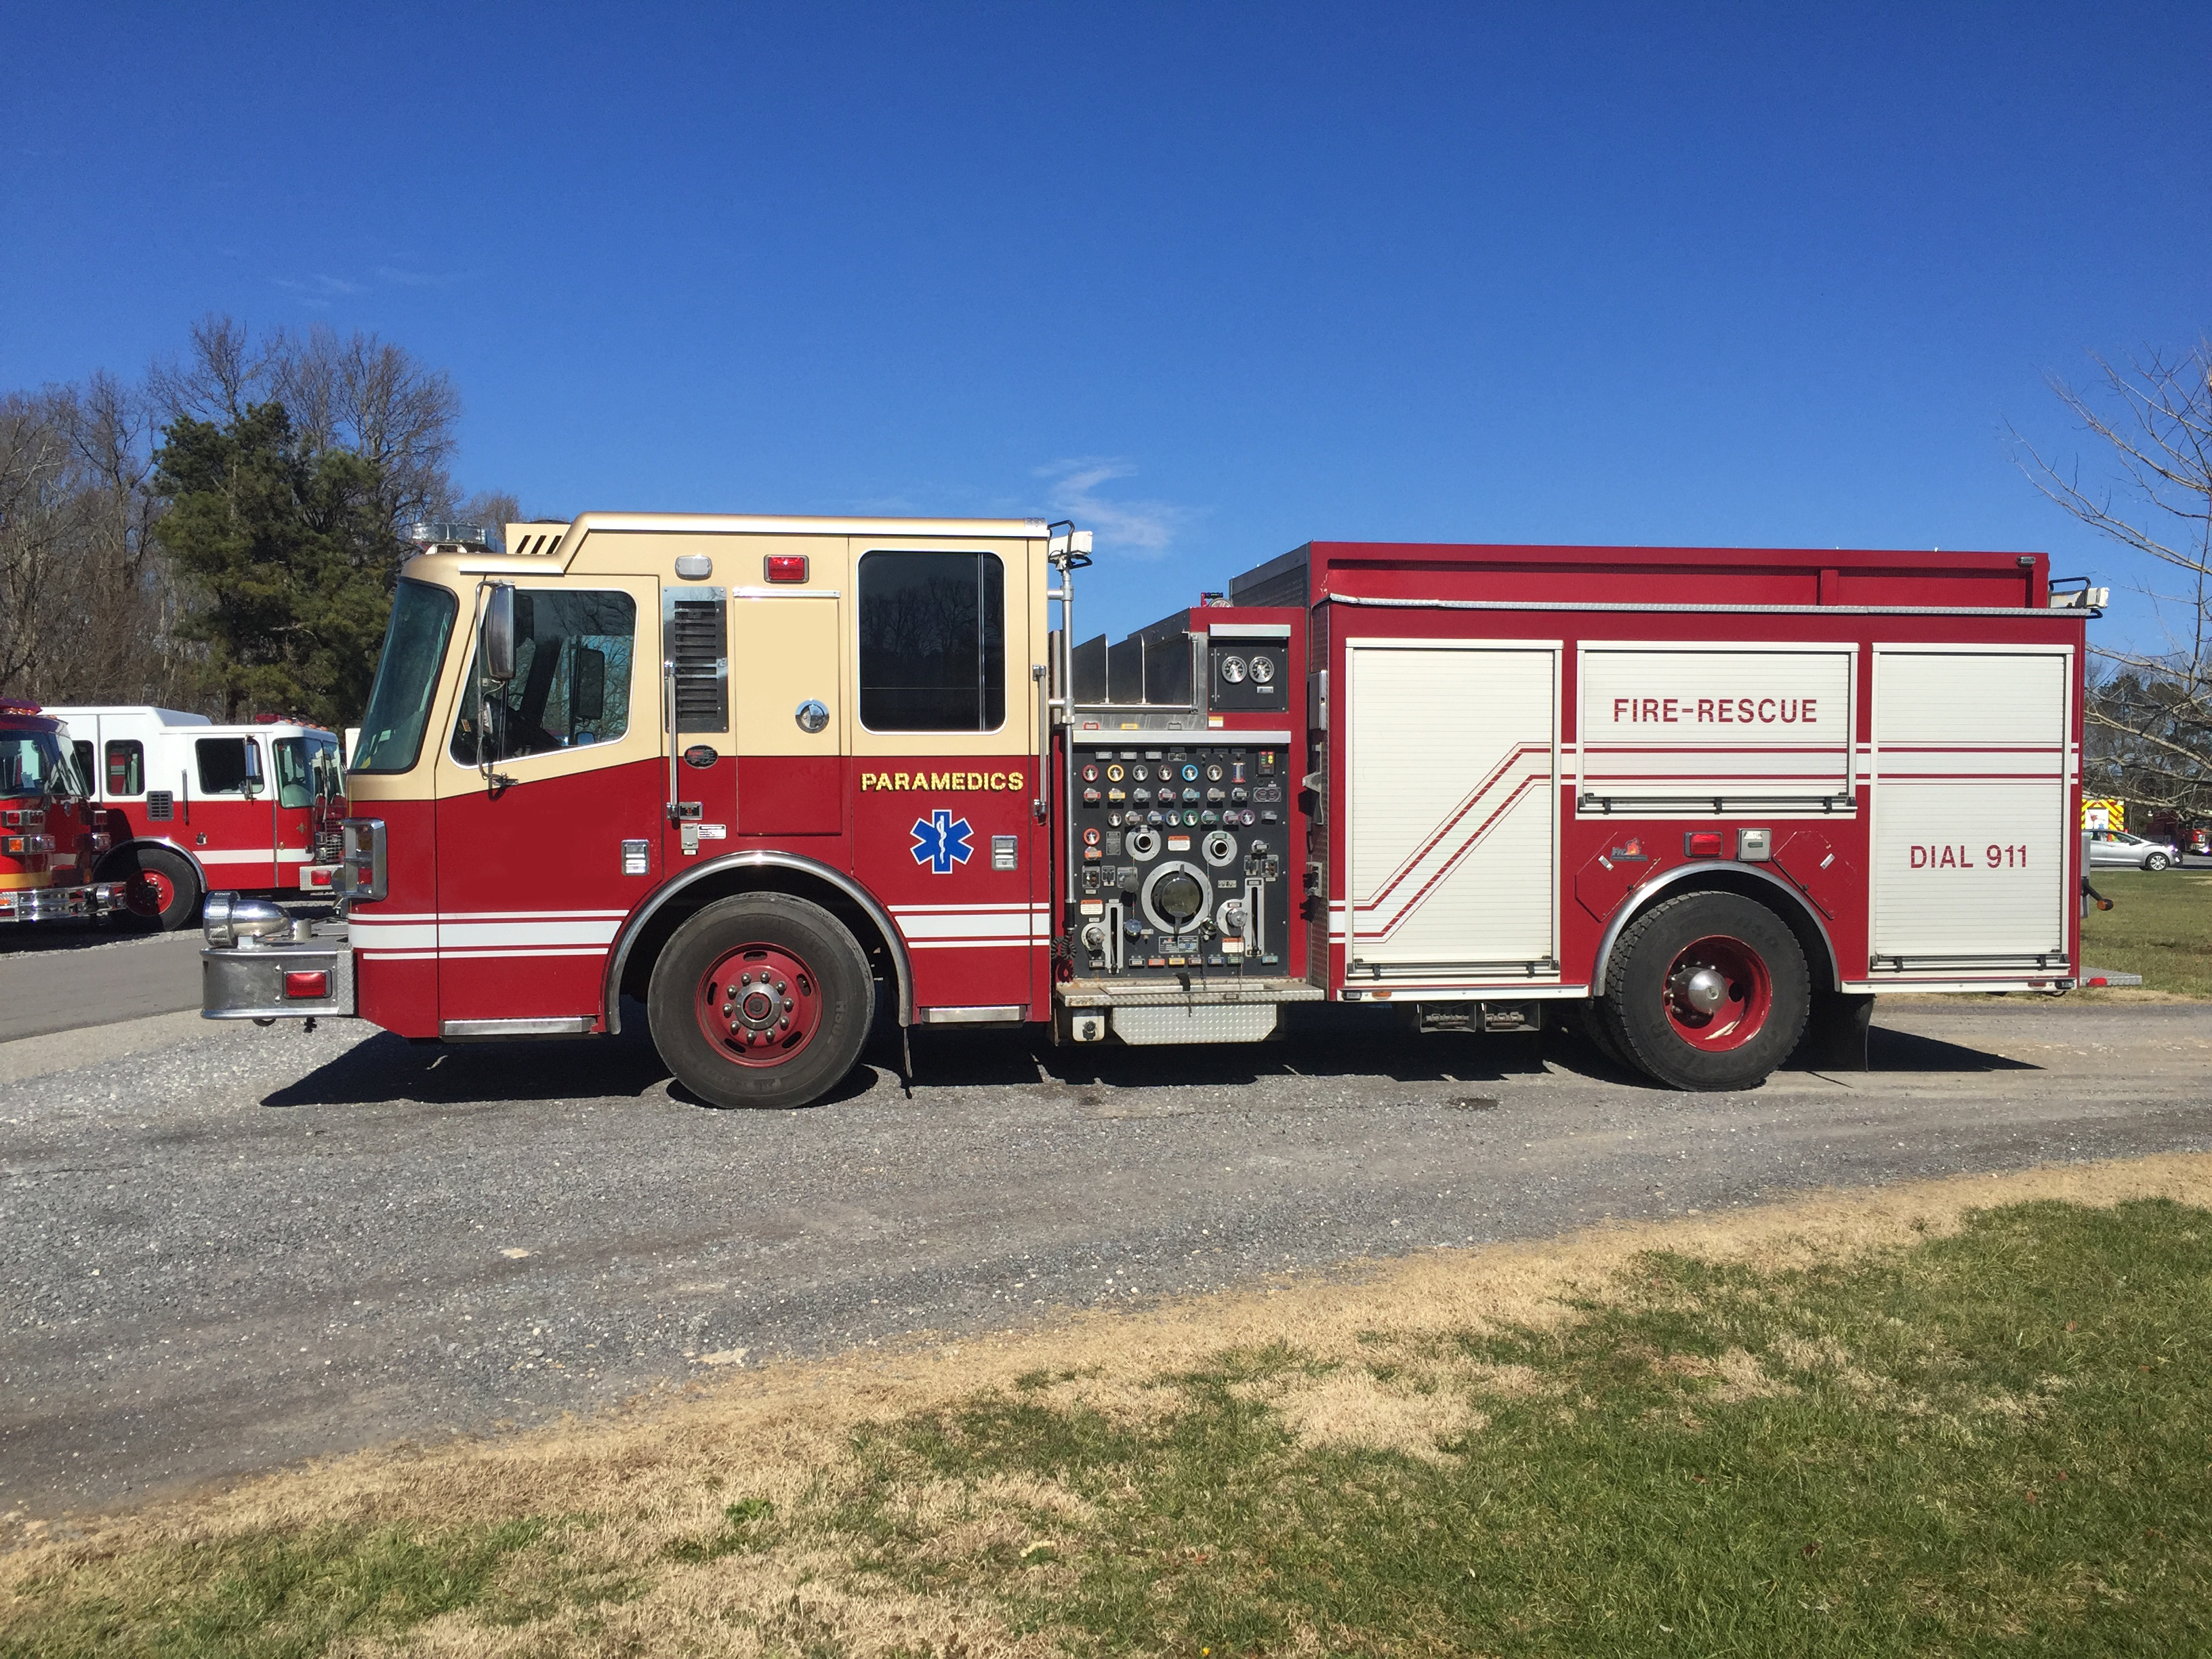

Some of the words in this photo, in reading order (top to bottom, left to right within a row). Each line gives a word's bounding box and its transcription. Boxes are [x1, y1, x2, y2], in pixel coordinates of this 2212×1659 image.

[1614, 698, 1817, 723] FIRE-RESCUE
[861, 772, 1024, 792] PARAMEDICS
[1910, 845, 1974, 869] DIAL
[1986, 844, 2026, 868] 911
